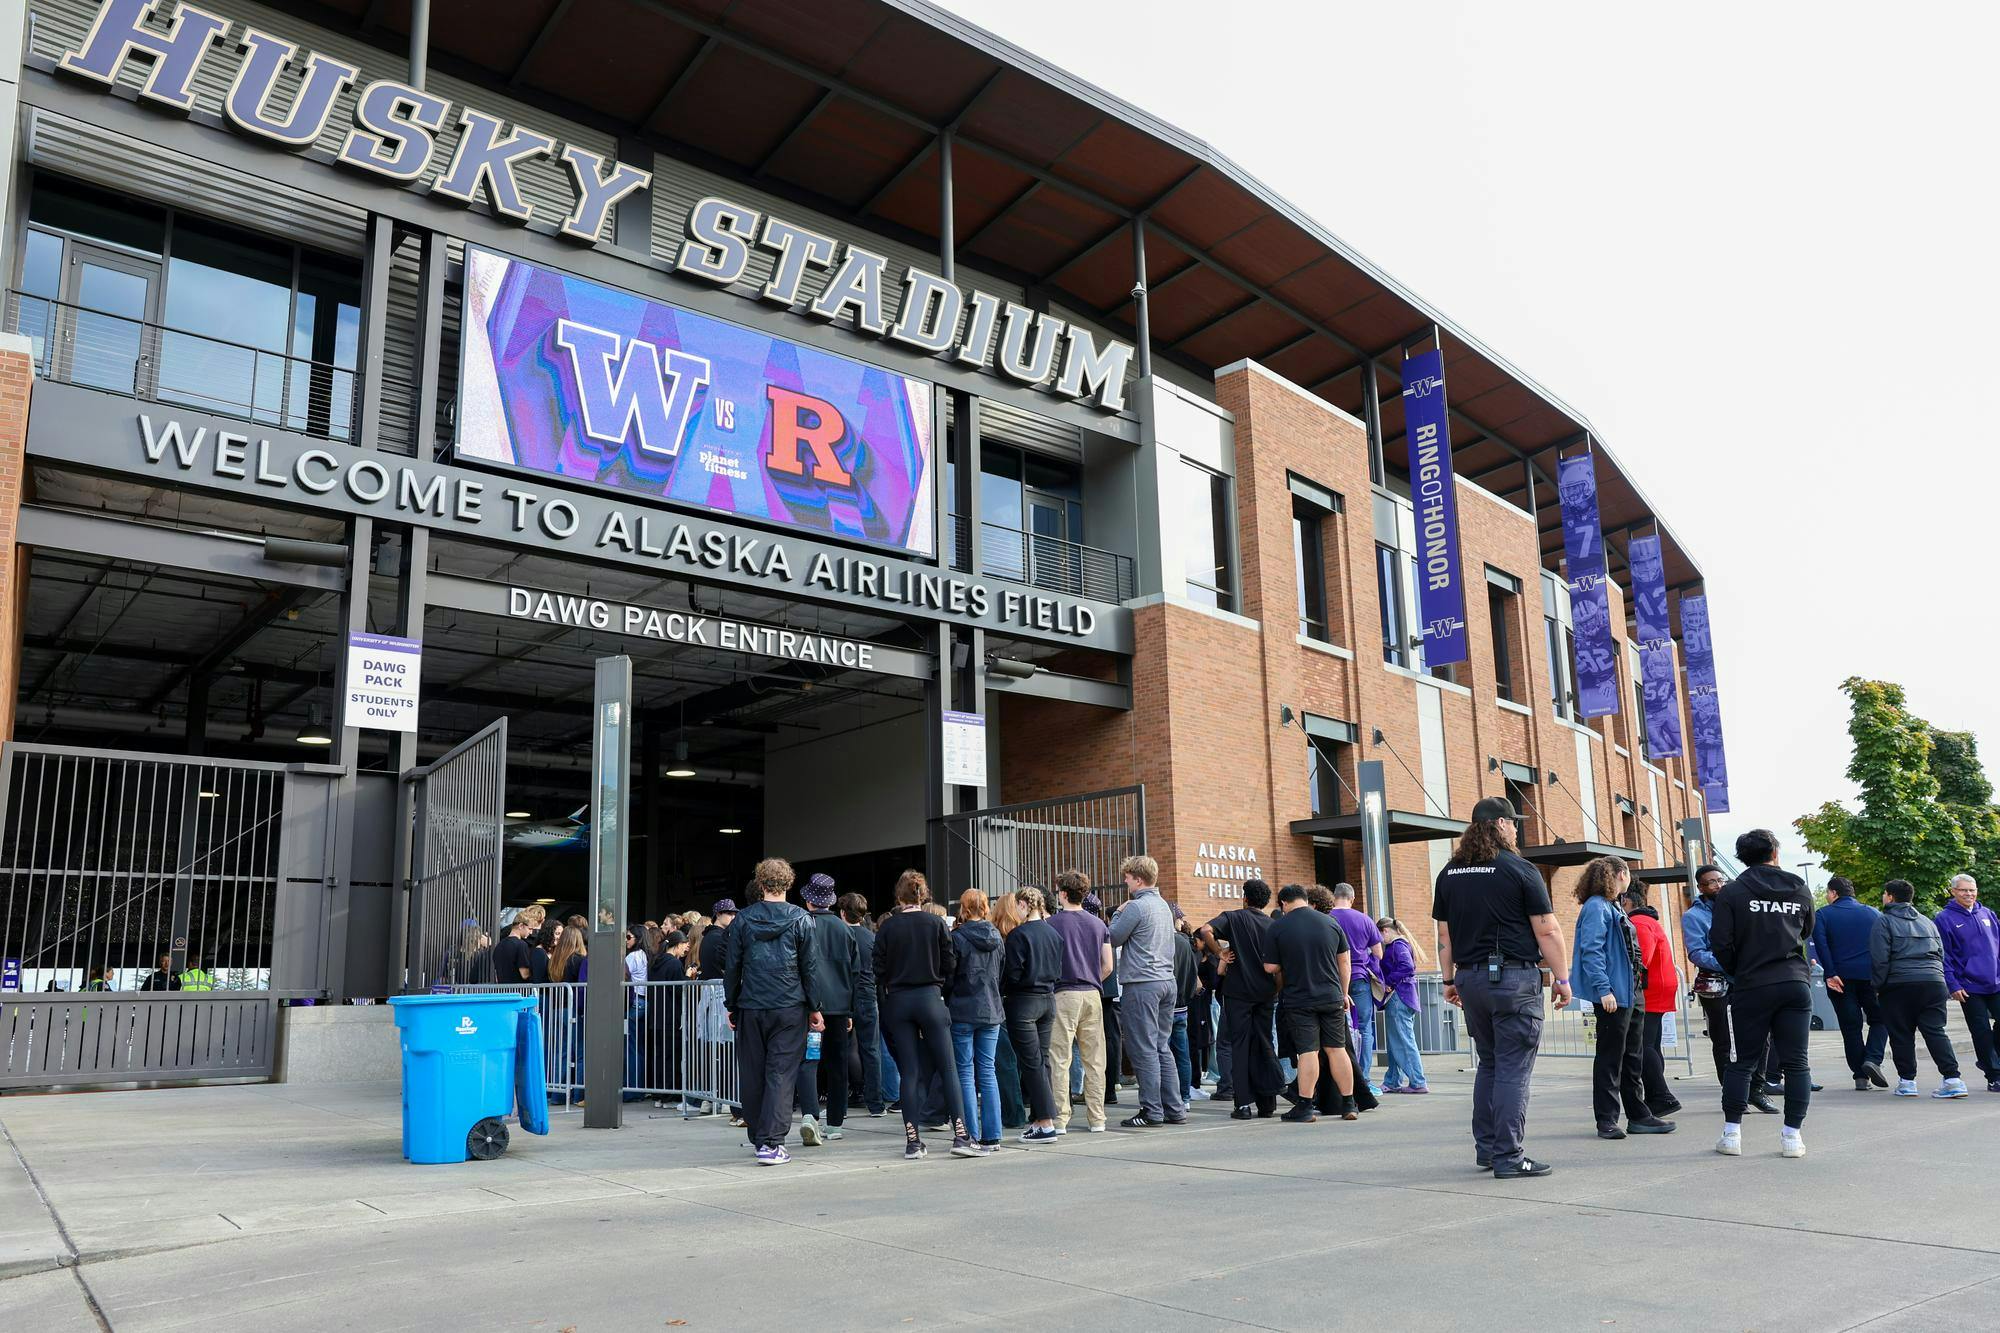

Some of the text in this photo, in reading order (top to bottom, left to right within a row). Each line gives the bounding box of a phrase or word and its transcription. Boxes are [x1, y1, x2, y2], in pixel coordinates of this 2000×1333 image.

[58, 0, 1134, 411] HUSKY STADIUM
[557, 318, 710, 456] W
[1410, 376, 1434, 398] W
[715, 398, 735, 430] VS
[766, 383, 851, 487] R
[699, 451, 740, 468] planet
[704, 460, 748, 480] fitness
[138, 414, 1096, 636] WELCOME TO ALASKA AIRLINES FIELD
[1575, 525, 1594, 558] 7
[1575, 574, 1597, 592] W
[510, 588, 873, 669] DAWG PACK ENTRANCE
[1430, 617, 1455, 638] W
[1645, 638, 1664, 652] W
[363, 660, 406, 674] DAWG
[365, 675, 403, 688] PACK
[1644, 681, 1671, 701] 54
[351, 693, 414, 708] STUDENTS
[367, 707, 397, 718] ONLY
[1198, 842, 1257, 862] ALASKA
[1194, 862, 1262, 880] AIRLINES
[1447, 866, 1496, 876] MANAGEMENT
[1208, 882, 1245, 899] FIEL
[1749, 900, 1801, 915] STAFF
[1522, 1161, 1532, 1170] N
